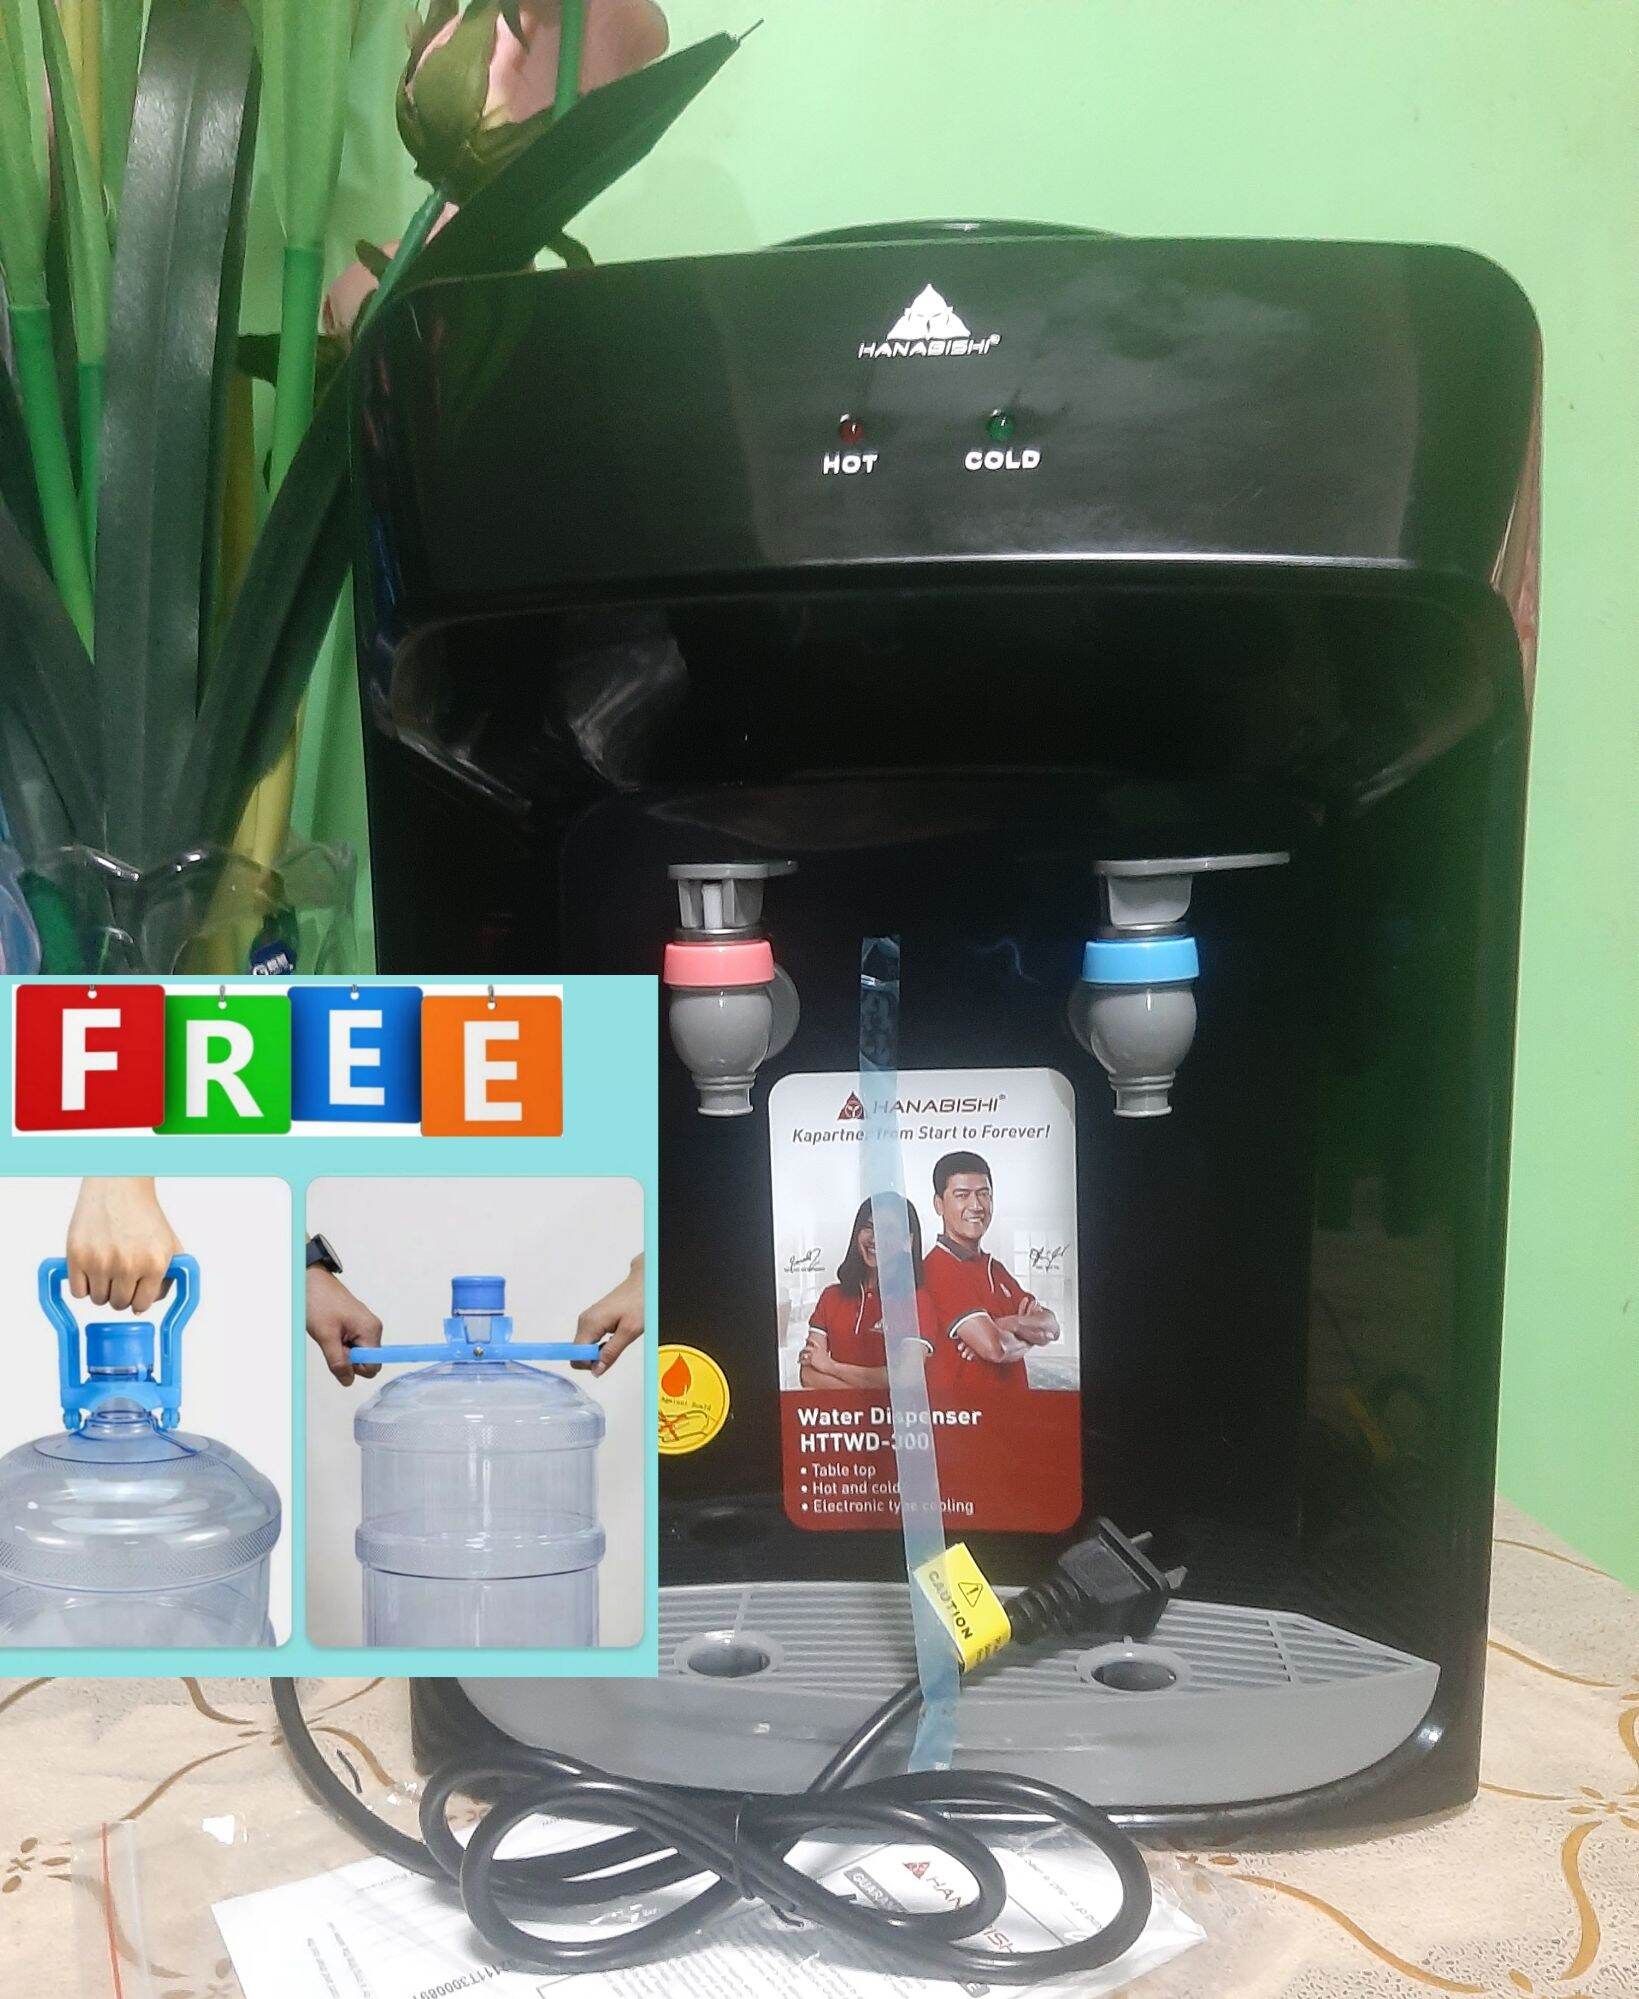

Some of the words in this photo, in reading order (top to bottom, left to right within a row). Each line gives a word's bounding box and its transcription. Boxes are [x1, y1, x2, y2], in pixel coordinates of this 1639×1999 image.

[858, 338, 991, 358] HANABISHI
[823, 452, 878, 475] HOT
[964, 450, 1041, 470] COLD
[873, 1097, 999, 1114] HANABISHI
[792, 1127, 867, 1145] Kapartne
[918, 1125, 957, 1140] Start
[962, 1125, 977, 1140] to
[981, 1124, 1051, 1140] Forever!
[798, 1407, 864, 1427] Water
[800, 1432, 930, 1452] HTTWD-300
[812, 1463, 849, 1477] Table
[853, 1463, 876, 1478] top
[812, 1481, 837, 1495] Hot
[841, 1480, 867, 1494] and
[813, 1498, 885, 1513] Electronic
[928, 1570, 973, 1639] CAUTION
